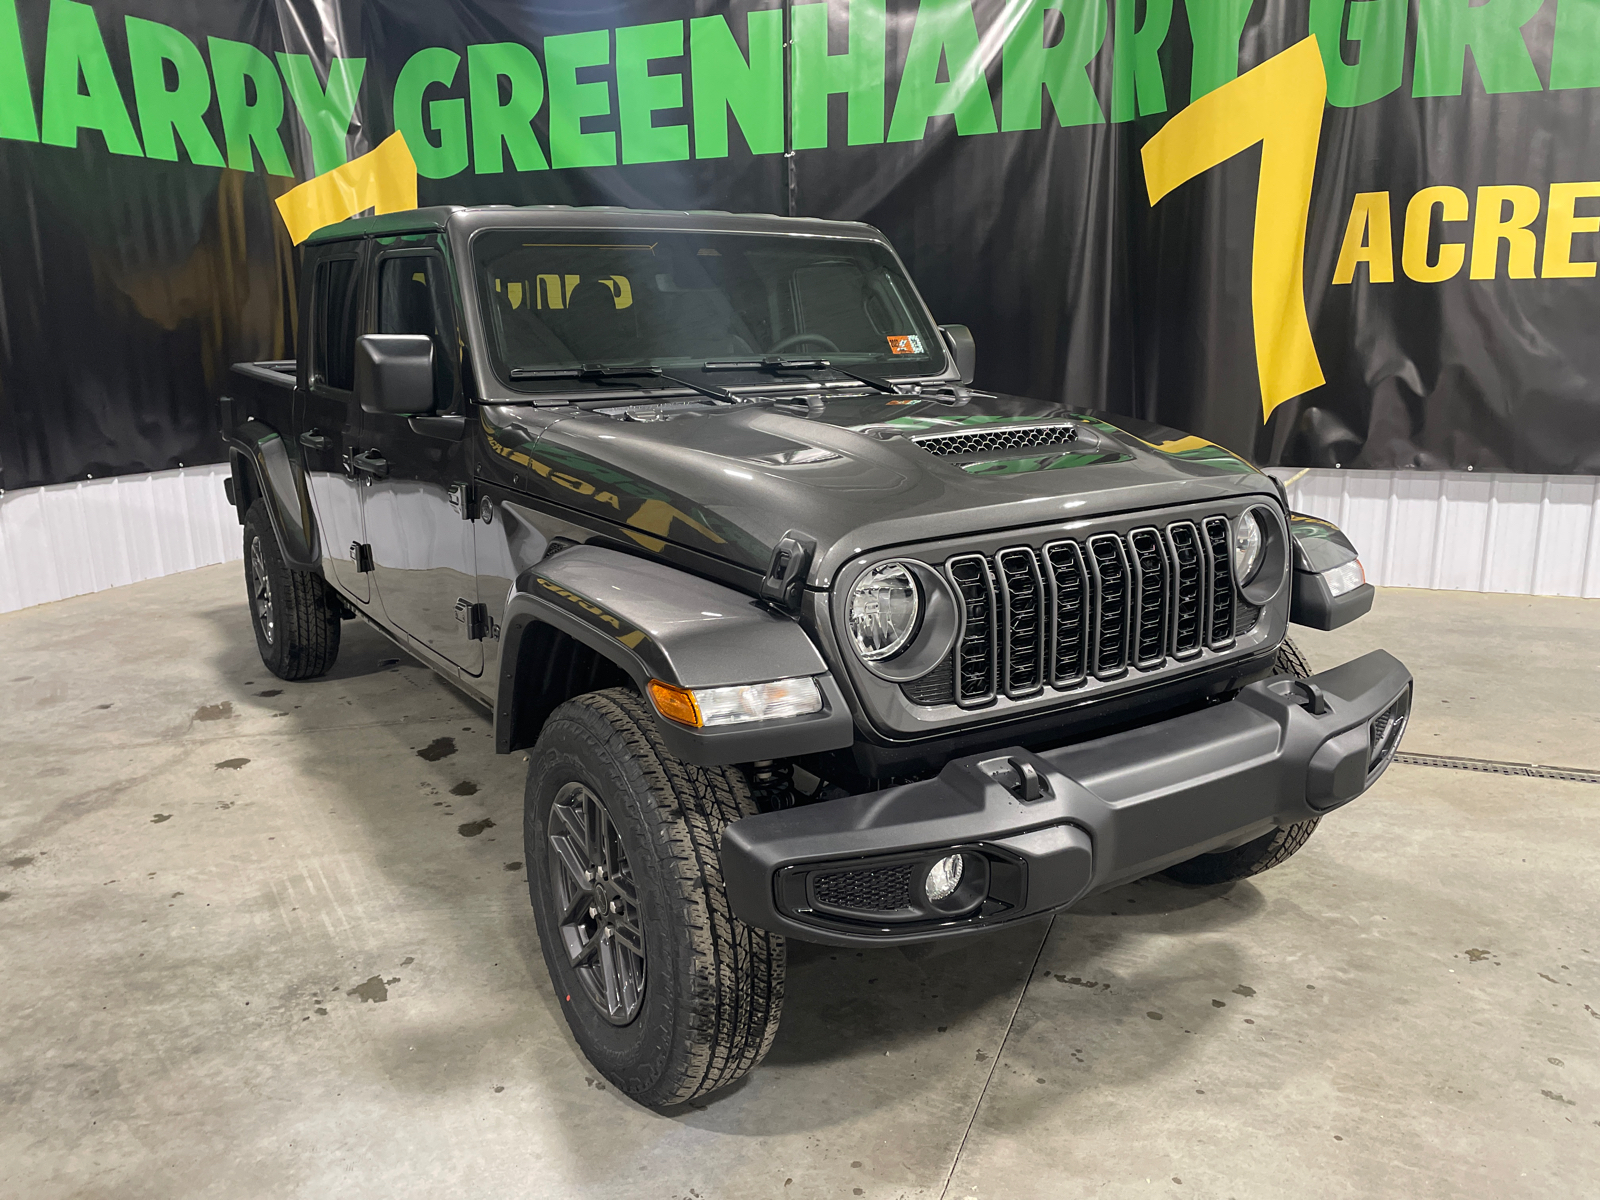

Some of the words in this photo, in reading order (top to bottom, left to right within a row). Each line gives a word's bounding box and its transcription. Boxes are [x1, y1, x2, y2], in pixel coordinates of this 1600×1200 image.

[393, 9, 783, 180] GREEN
[792, 0, 1252, 151] HARRY
[1141, 33, 1327, 425] 7
[1332, 181, 1600, 285] ACRE
